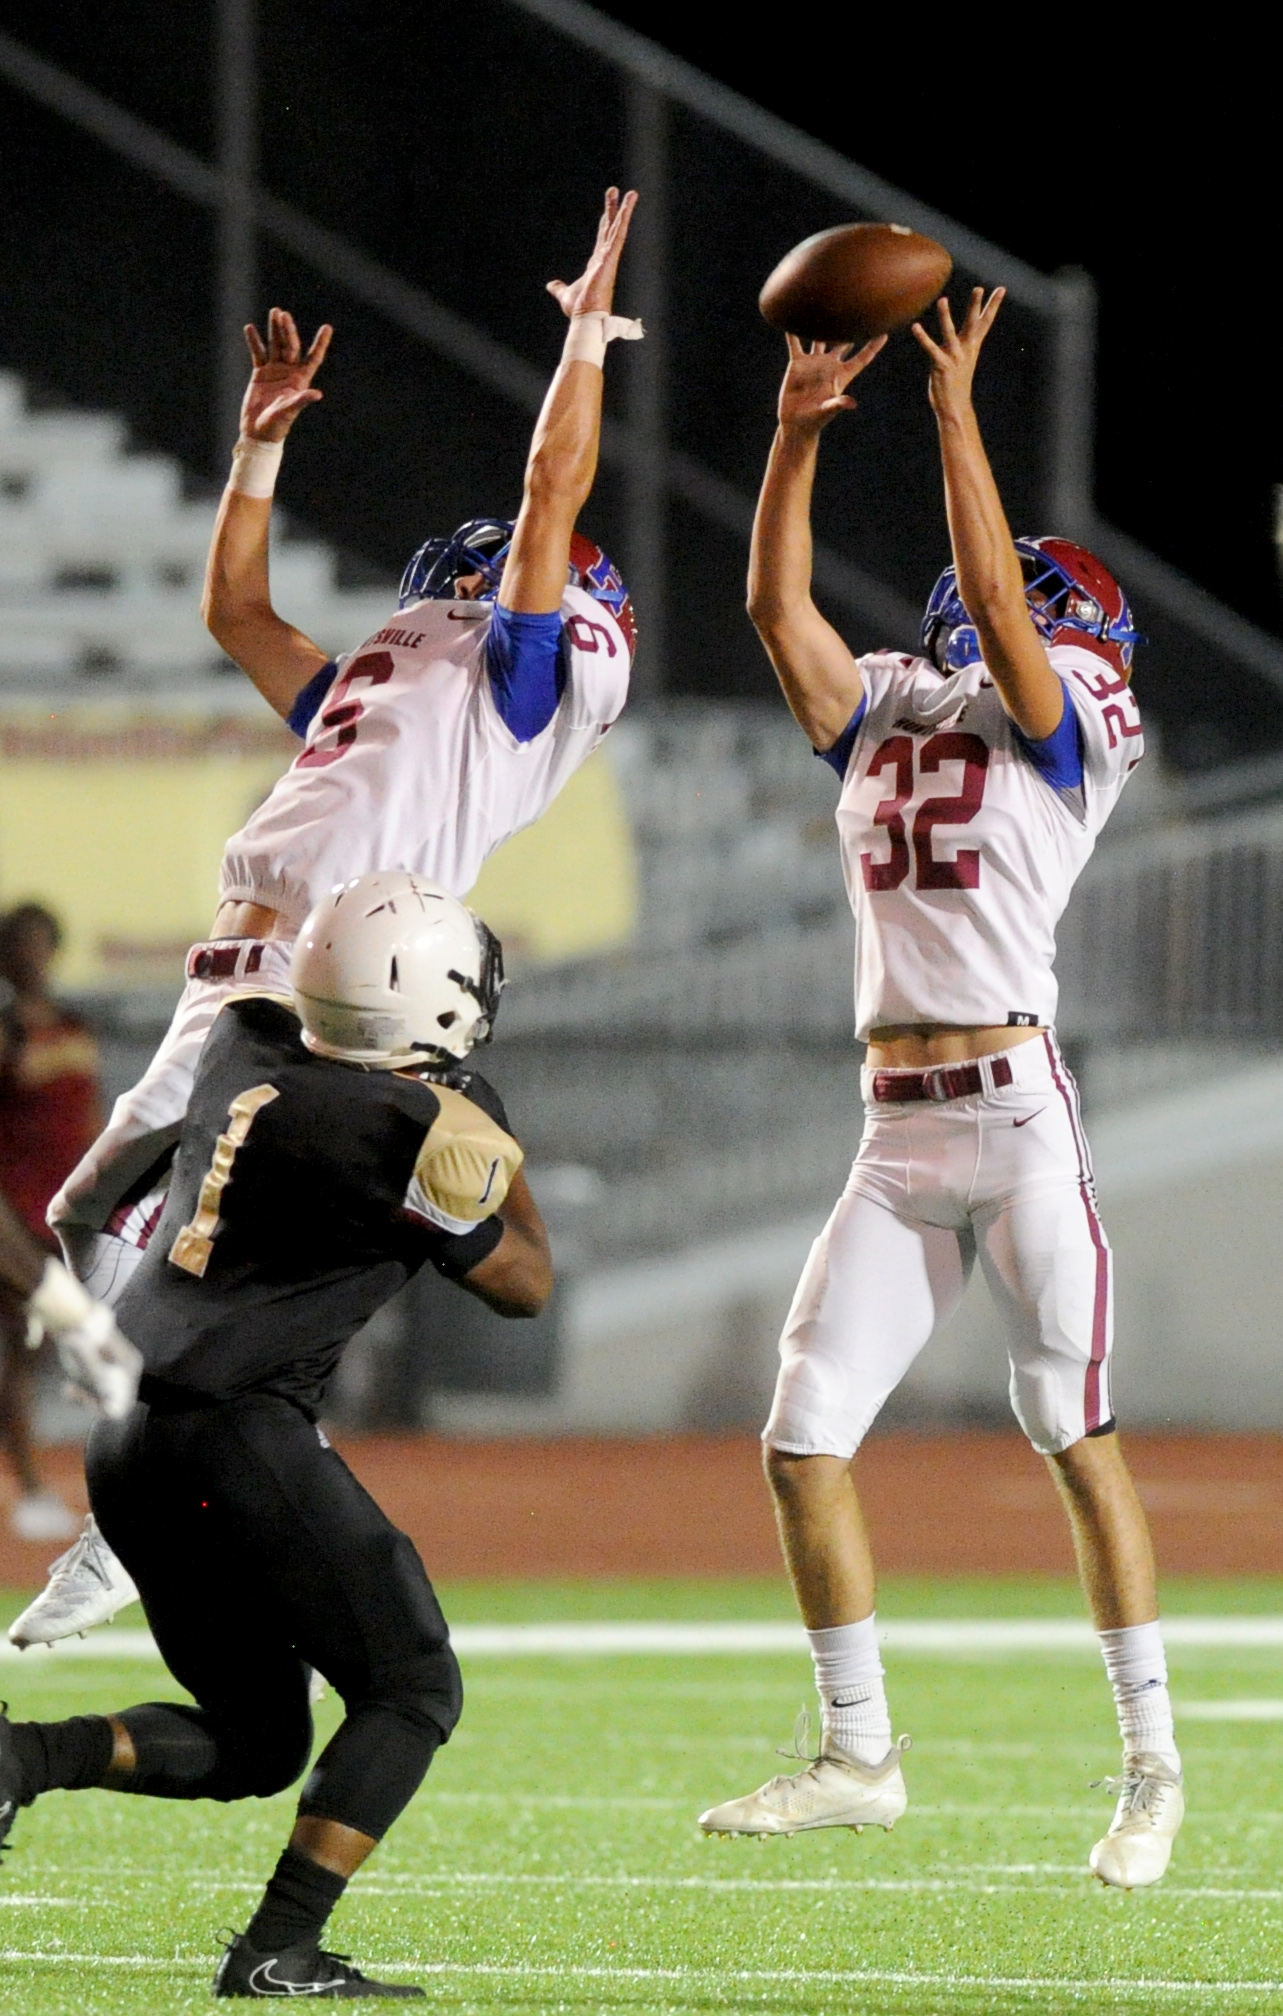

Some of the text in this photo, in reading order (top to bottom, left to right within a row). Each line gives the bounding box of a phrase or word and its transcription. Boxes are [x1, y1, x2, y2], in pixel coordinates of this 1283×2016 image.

[566, 614, 617, 658] 6
[295, 651, 395, 768] 6
[1071, 669, 1143, 750] 32
[861, 732, 990, 892] 32
[168, 1083, 281, 1278] 1
[478, 1157, 500, 1204] 1
